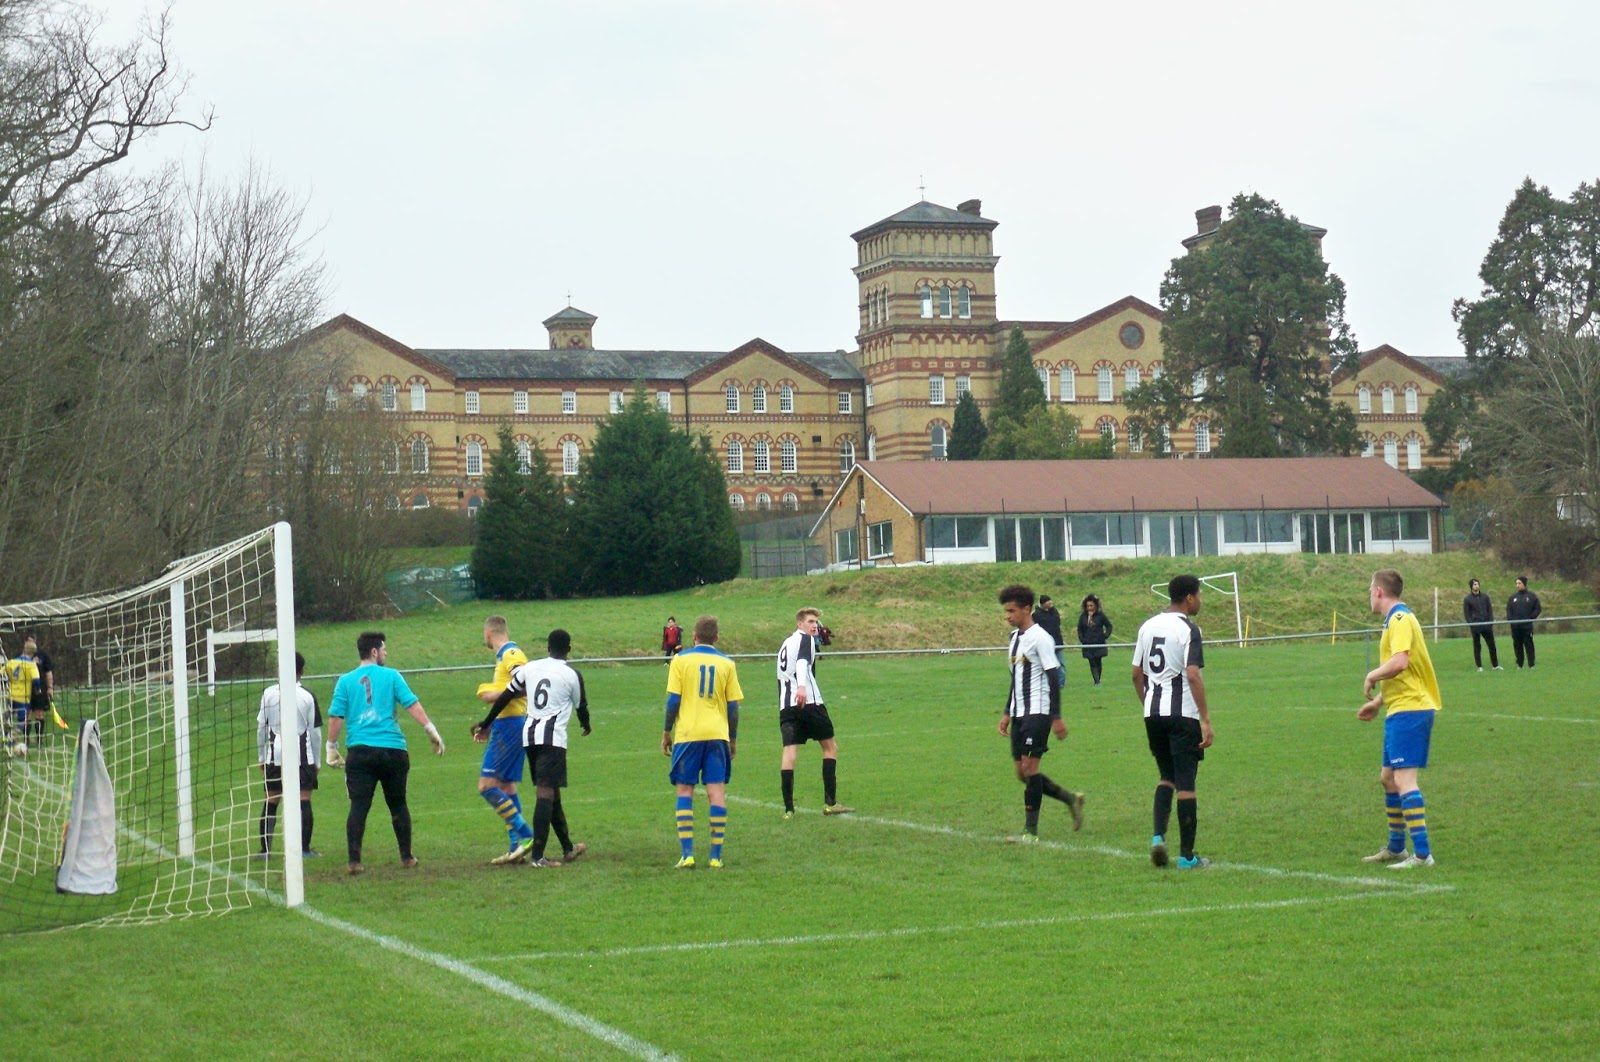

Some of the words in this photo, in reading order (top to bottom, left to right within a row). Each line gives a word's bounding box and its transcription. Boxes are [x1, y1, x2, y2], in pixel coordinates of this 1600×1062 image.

[780, 645, 787, 672] 9
[1149, 636, 1166, 674] 5
[12, 665, 21, 681] 4
[699, 664, 715, 698] 11
[359, 675, 372, 705] 1
[534, 678, 551, 710] 6
